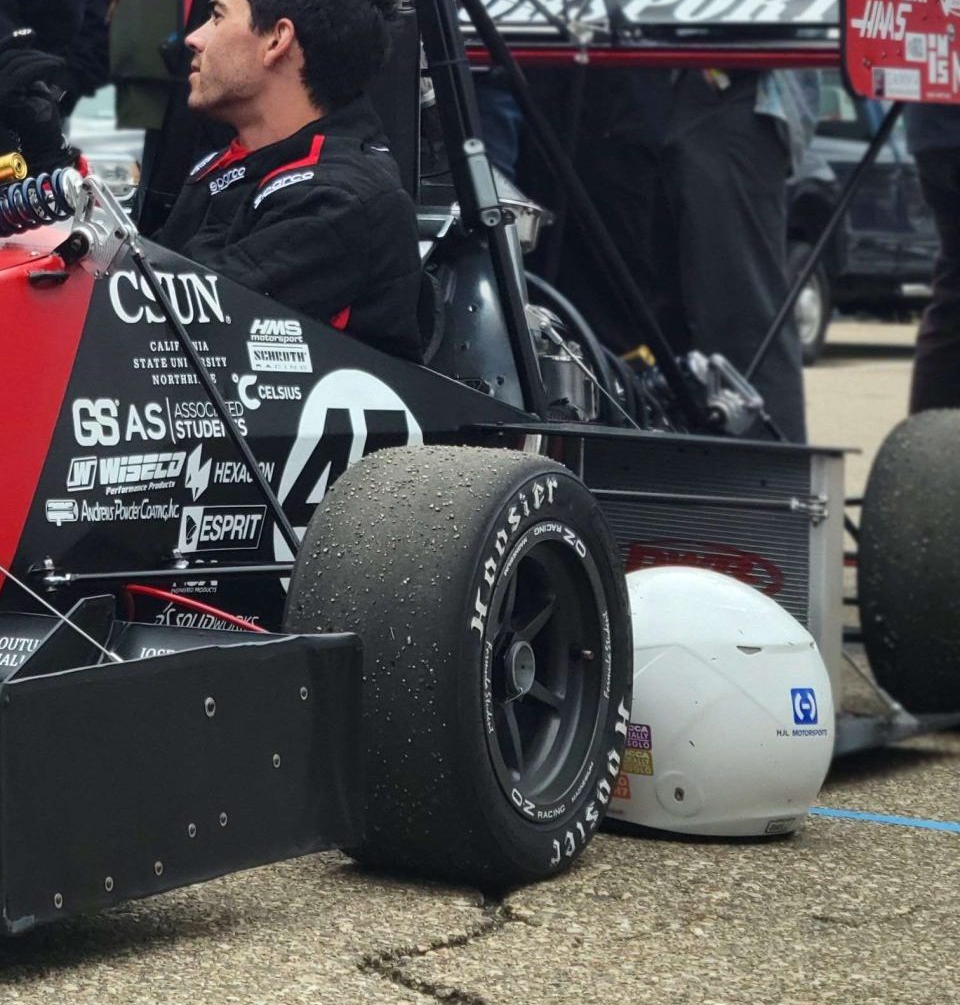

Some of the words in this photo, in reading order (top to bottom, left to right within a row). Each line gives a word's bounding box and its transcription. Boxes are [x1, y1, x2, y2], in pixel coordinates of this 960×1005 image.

[250, 319, 302, 336] HMS
[150, 341, 209, 352] CALIFNIA
[250, 334, 303, 344] motorsport
[133, 358, 168, 369] STATE
[152, 374, 216, 385] NORTHRIE
[258, 385, 302, 400] CELSIUS
[125, 403, 166, 442] AS
[105, 484, 147, 496] Performance
[148, 480, 176, 492] Products
[199, 514, 263, 542] ESPRIT
[533, 523, 562, 536] RACING
[537, 804, 566, 819] RACING
